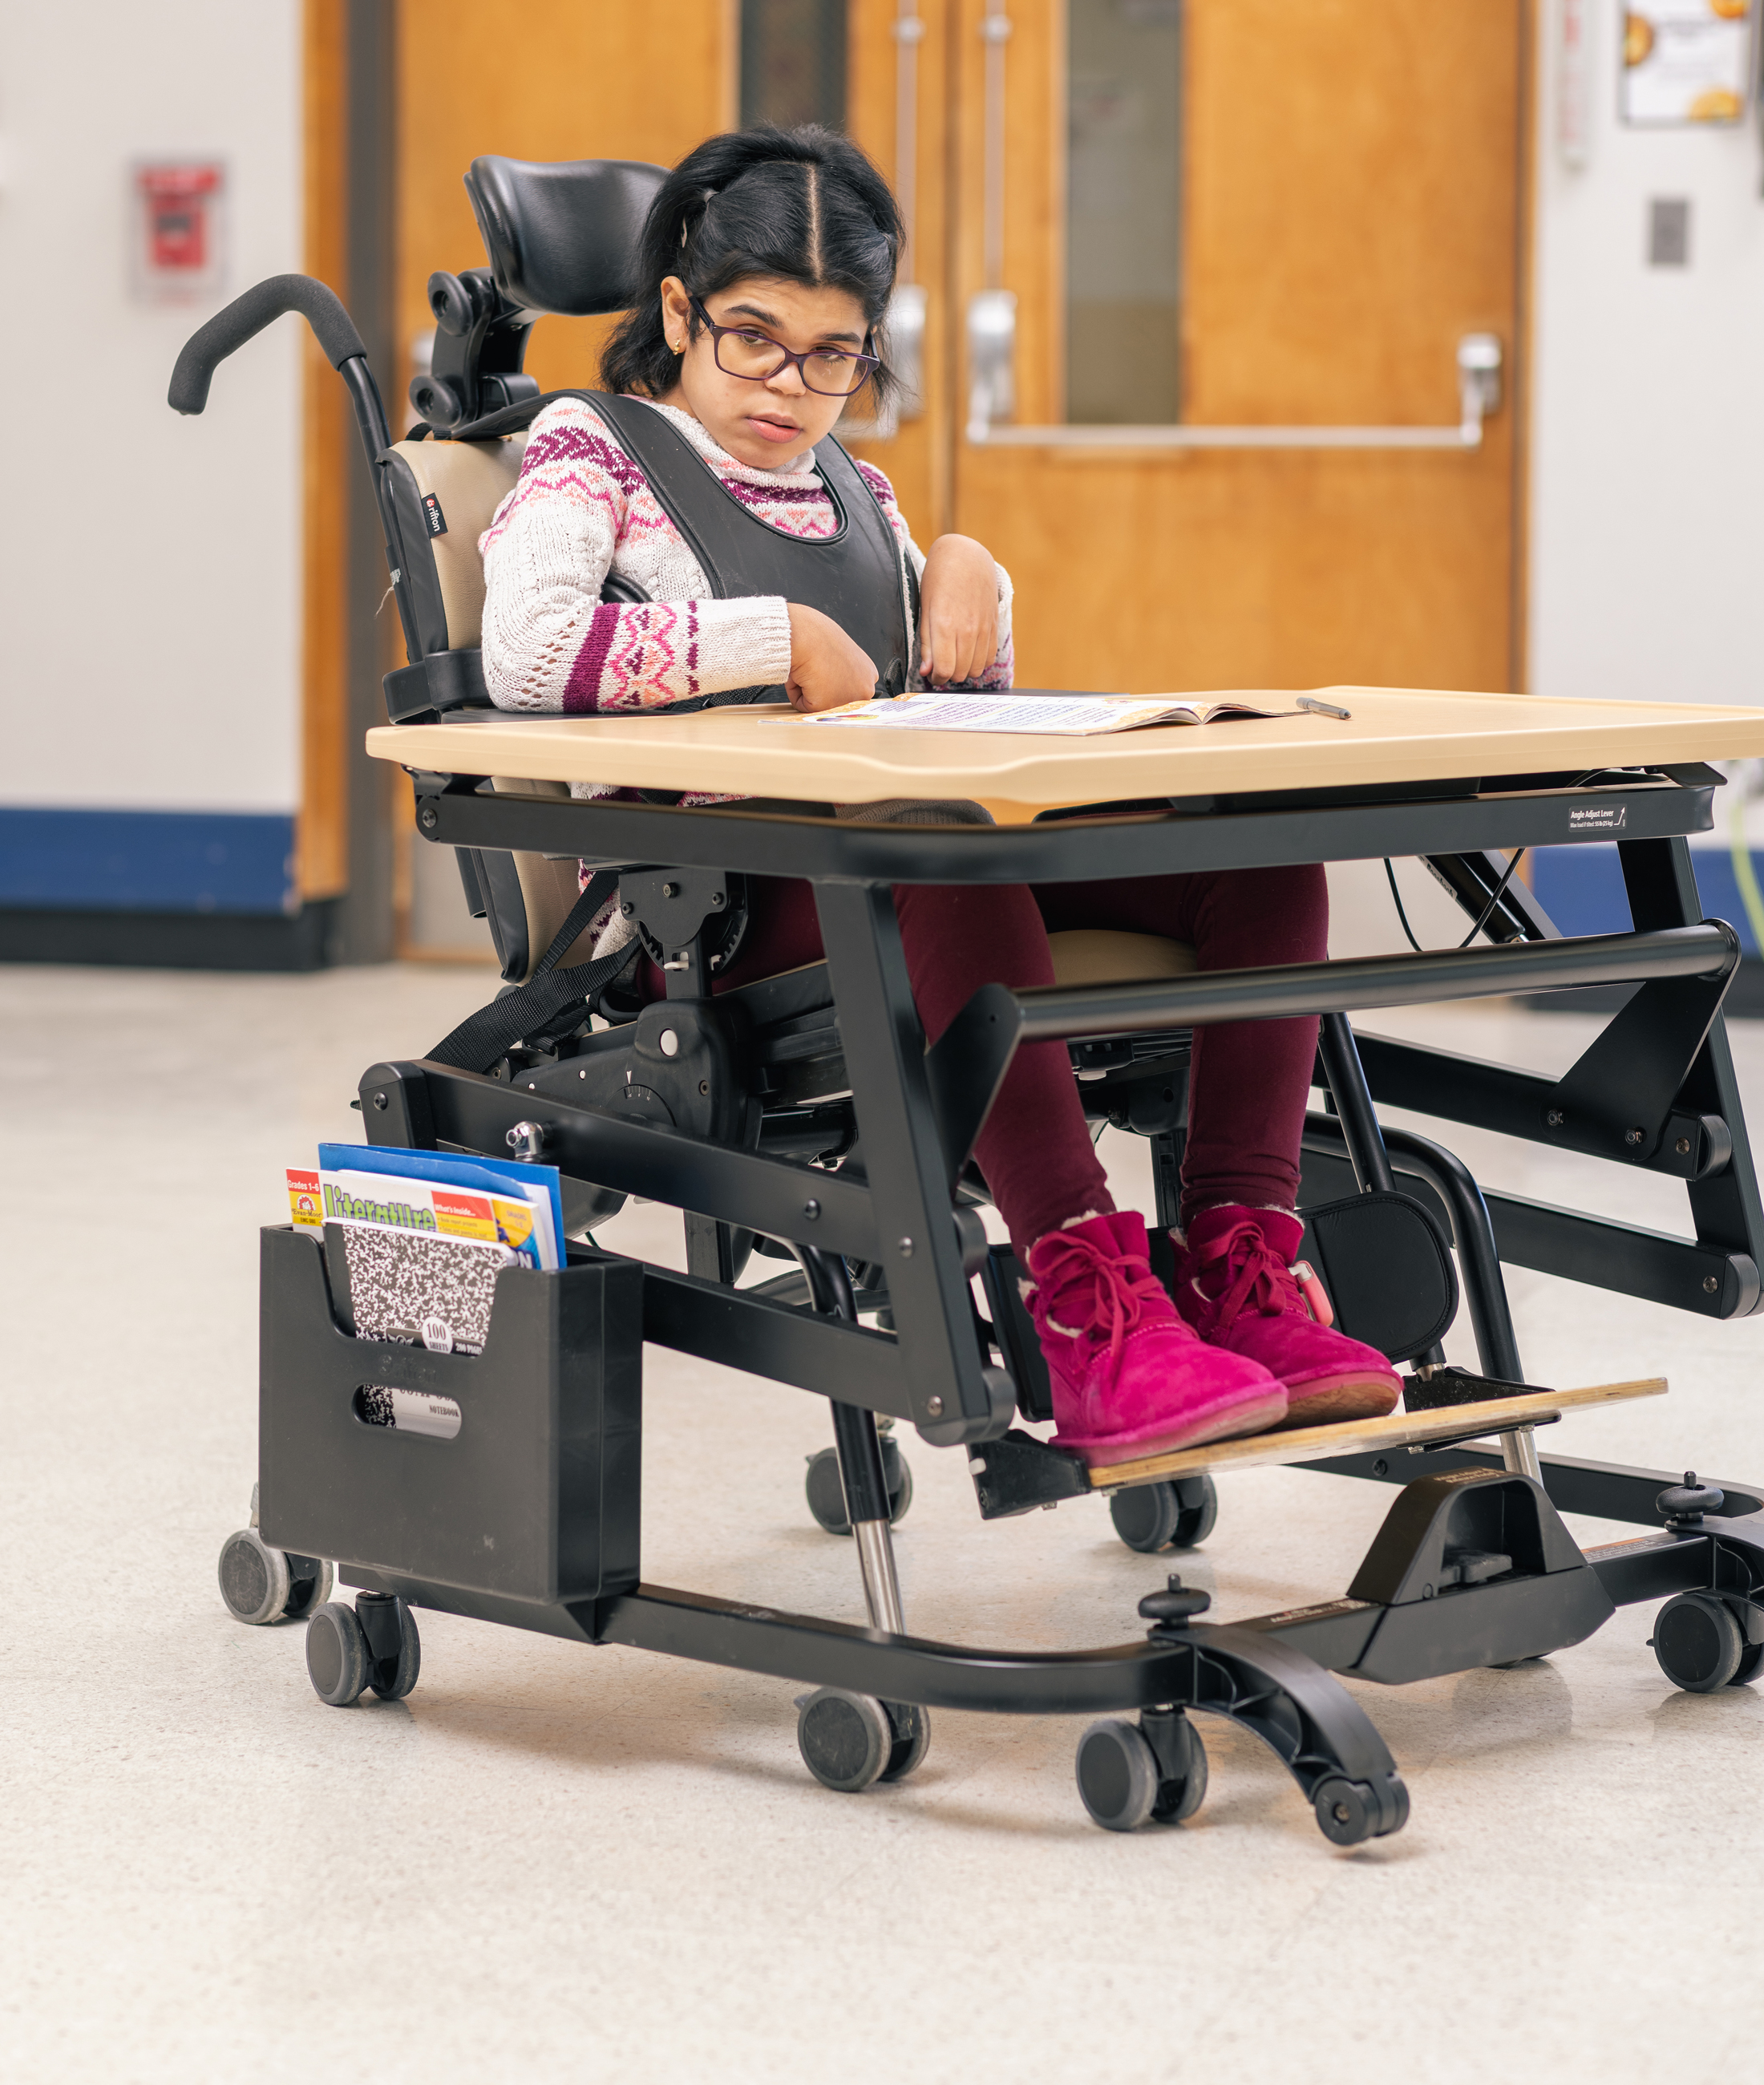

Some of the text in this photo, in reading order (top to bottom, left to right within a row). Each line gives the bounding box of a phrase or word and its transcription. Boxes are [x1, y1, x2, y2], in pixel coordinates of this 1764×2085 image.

[428, 507, 440, 532] rifton
[1571, 809, 1614, 820] Angle Adjust Lever
[288, 1180, 308, 1190] Grades
[435, 1204, 454, 1214] What's
[427, 1322, 447, 1340] 100
[429, 1341, 449, 1351] SHEETS
[455, 1342, 467, 1353] 200
[429, 1404, 459, 1418] NOTEBOOK
